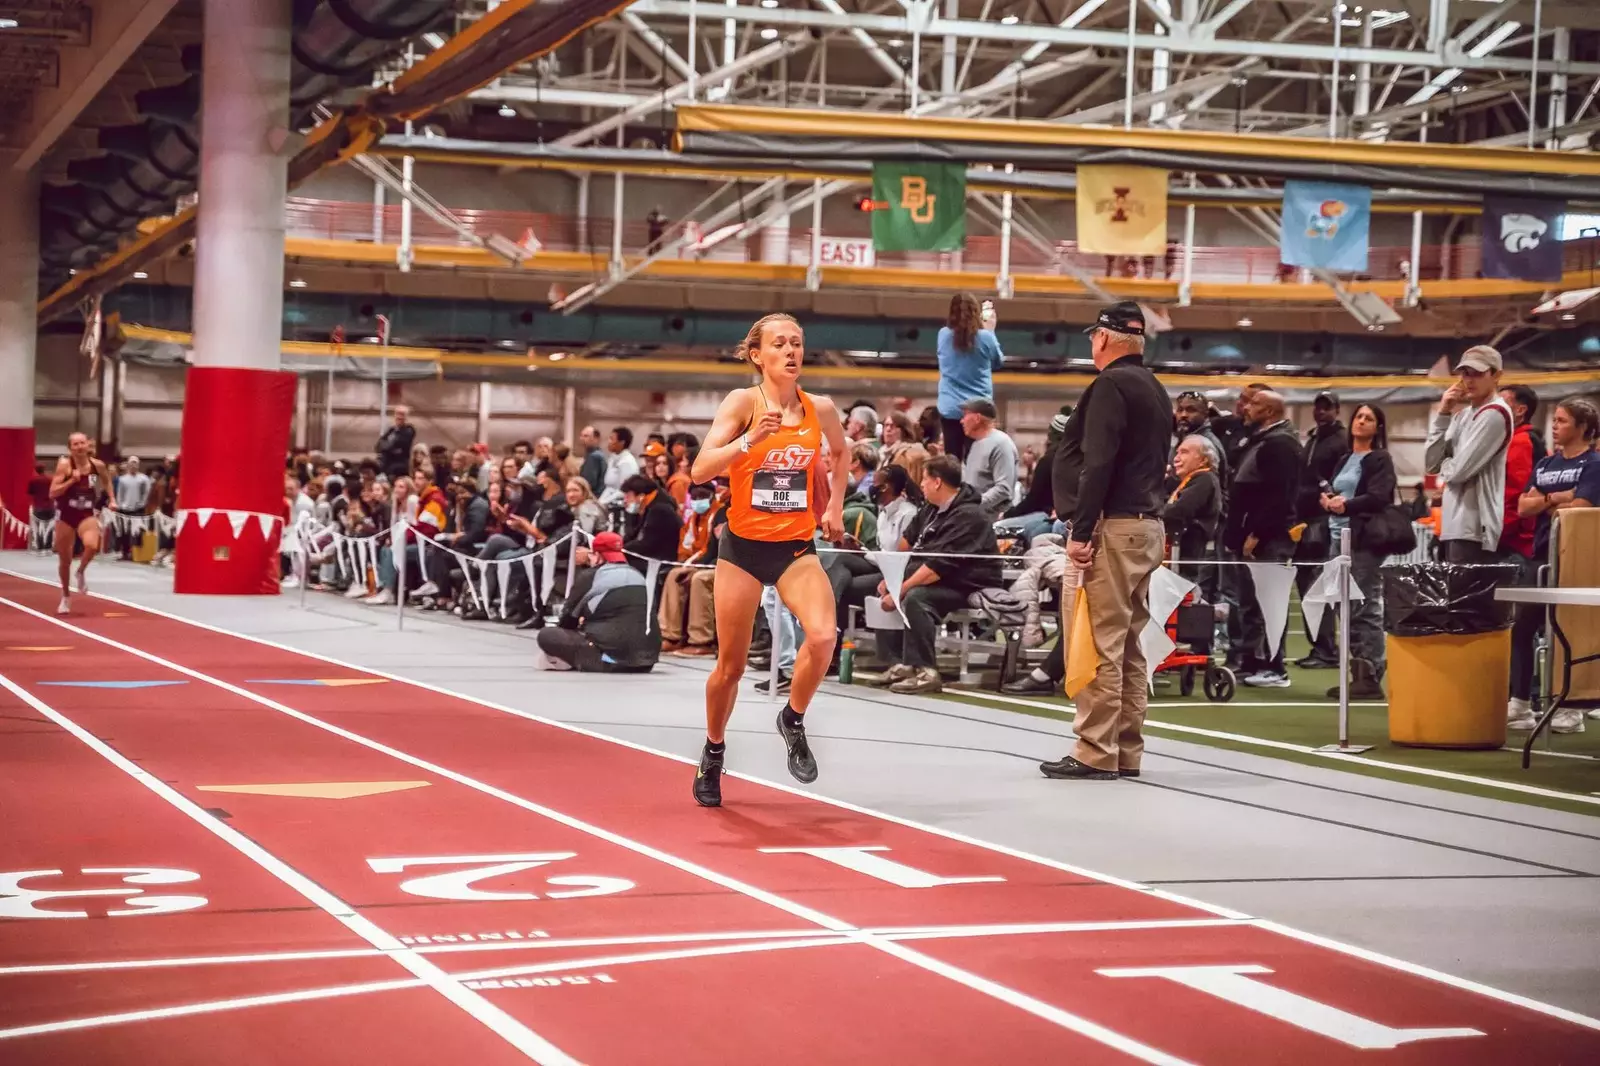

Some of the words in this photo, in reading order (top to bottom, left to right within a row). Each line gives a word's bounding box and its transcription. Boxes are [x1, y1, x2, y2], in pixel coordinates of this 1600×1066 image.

[901, 175, 936, 224] BU
[821, 243, 868, 263] EAST
[762, 444, 816, 470] OSU
[773, 491, 790, 501] ROE
[366, 852, 636, 900] 2
[756, 846, 1008, 888] 1
[0, 867, 208, 918] 3
[1092, 964, 1488, 1049] 1
